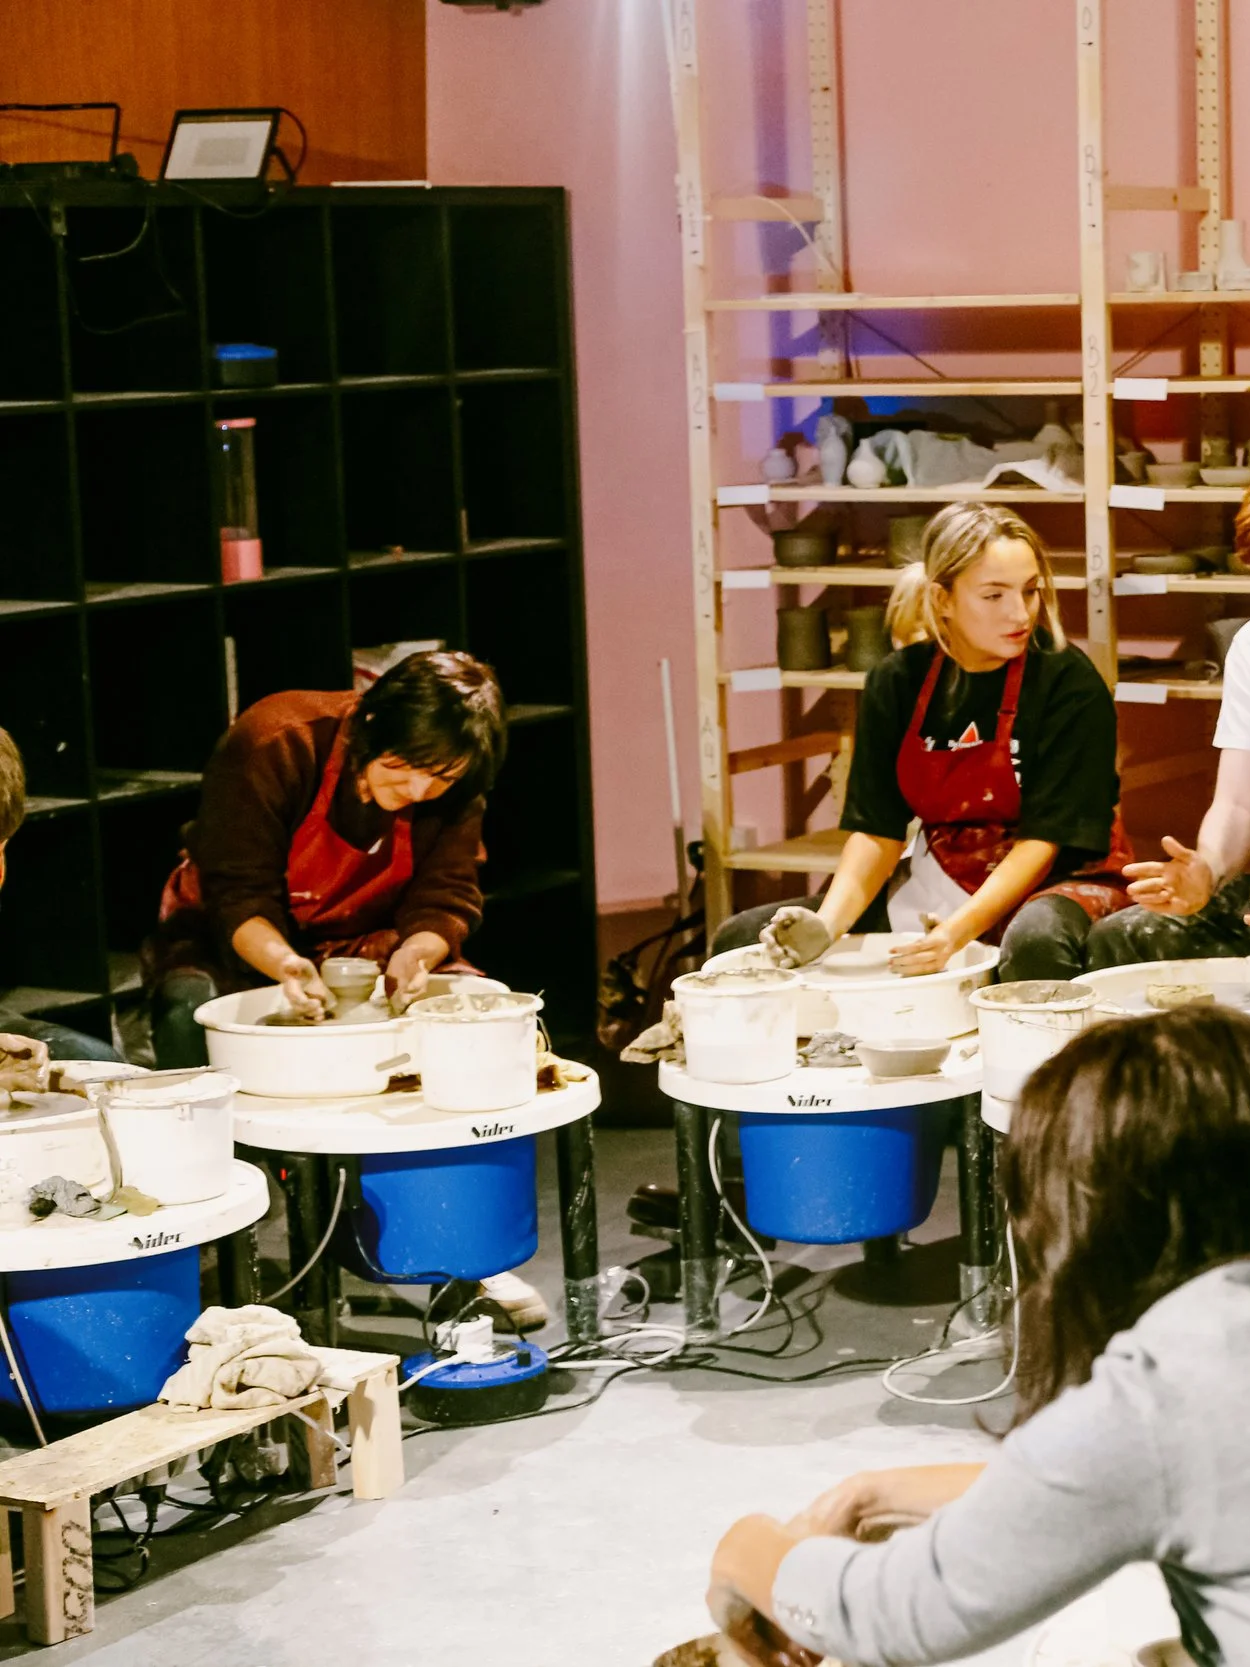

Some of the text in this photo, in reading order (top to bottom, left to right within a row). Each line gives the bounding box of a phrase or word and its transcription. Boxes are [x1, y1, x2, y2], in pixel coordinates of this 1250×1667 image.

[1084, 144, 1097, 207] B1
[1087, 335, 1101, 397] B2
[1090, 545, 1104, 598] B3
